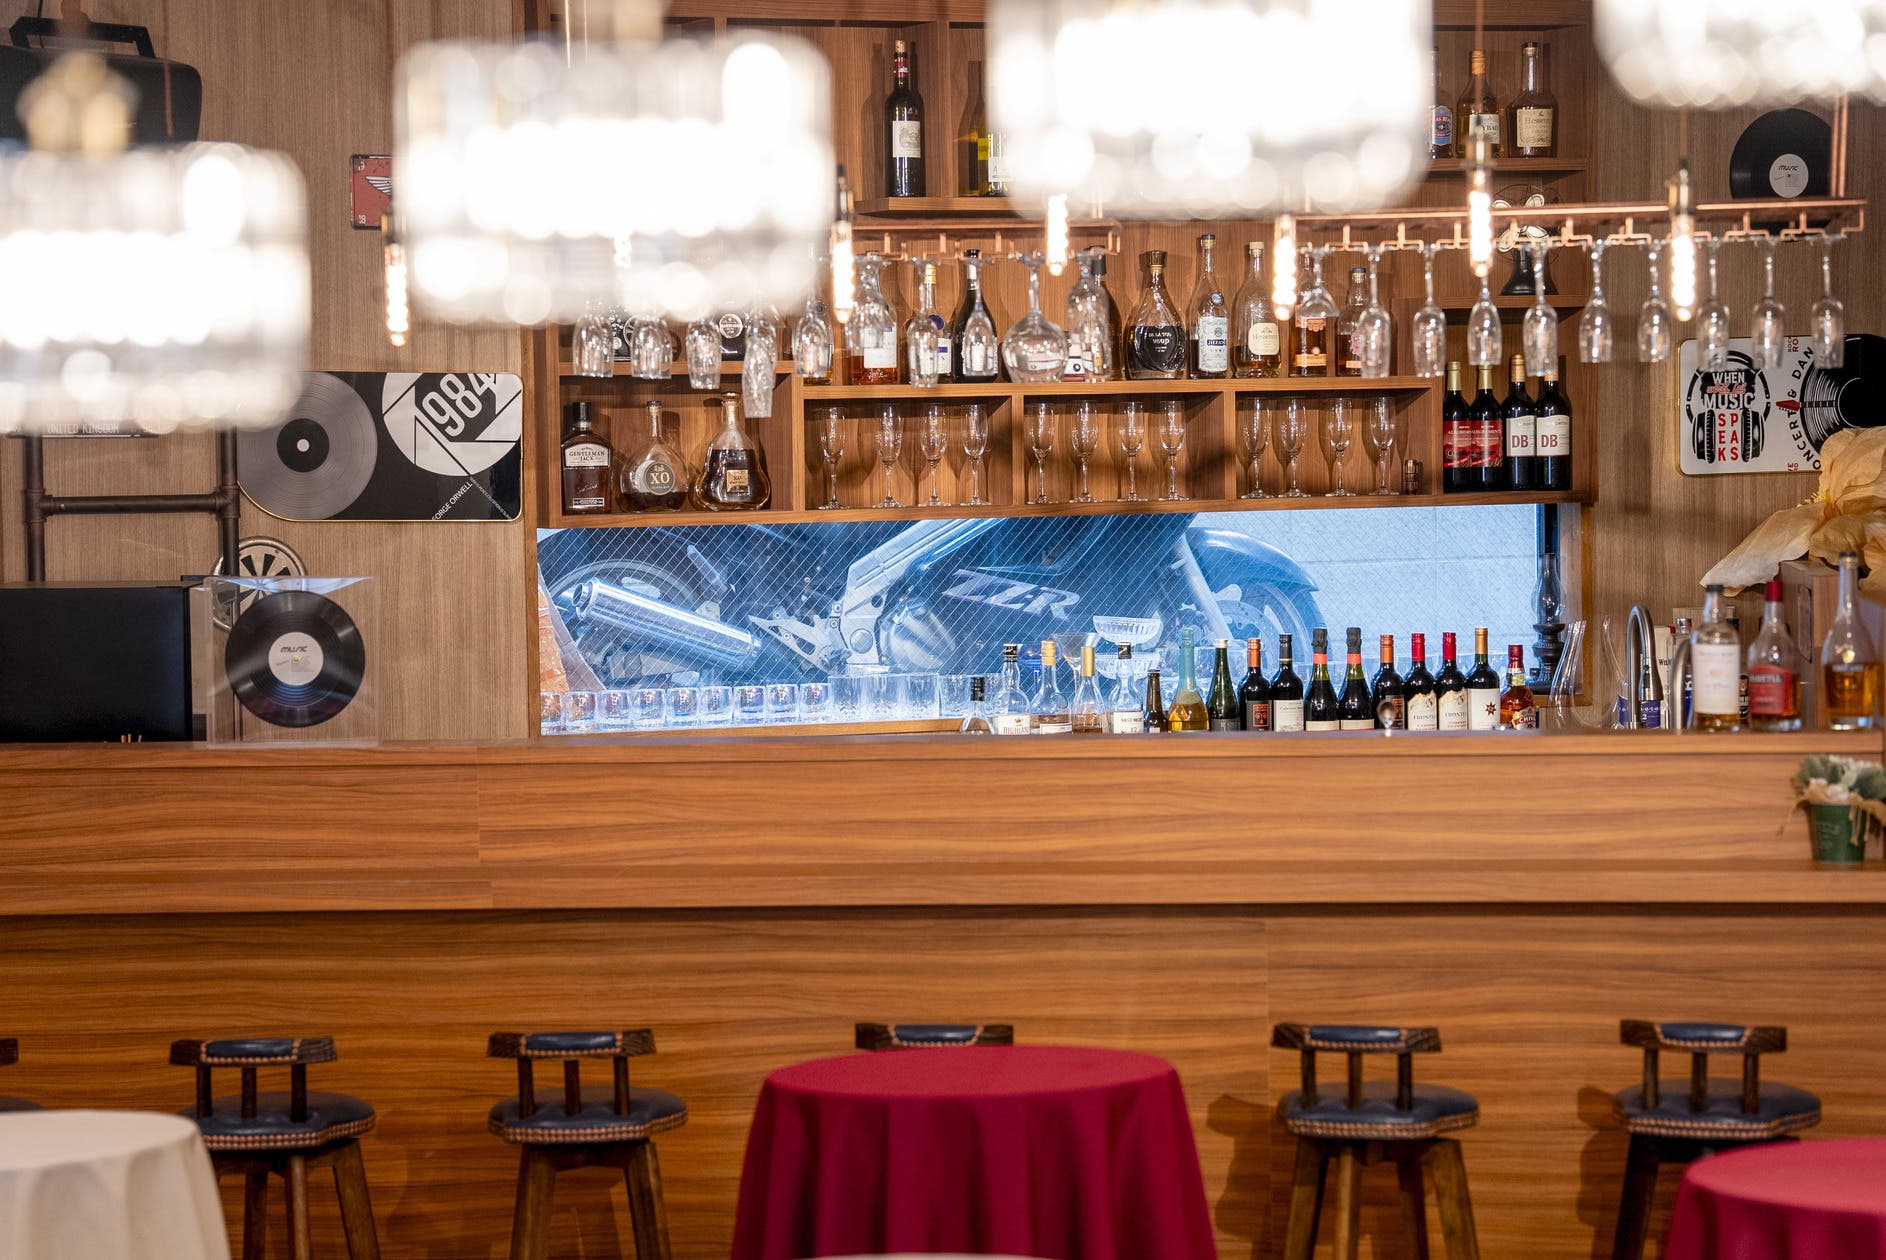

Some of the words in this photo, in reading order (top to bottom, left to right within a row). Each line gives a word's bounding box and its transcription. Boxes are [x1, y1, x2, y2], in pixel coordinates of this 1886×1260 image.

[1712, 371, 1745, 386] WHEN
[414, 373, 497, 442] 1984
[1704, 392, 1754, 410] MUSIC
[47, 424, 78, 434] UNITED
[1511, 434, 1529, 448] DB
[1541, 434, 1558, 448] DB
[650, 472, 670, 485] XO
[449, 481, 473, 505] ORWELL
[941, 569, 1081, 621] ZZR
